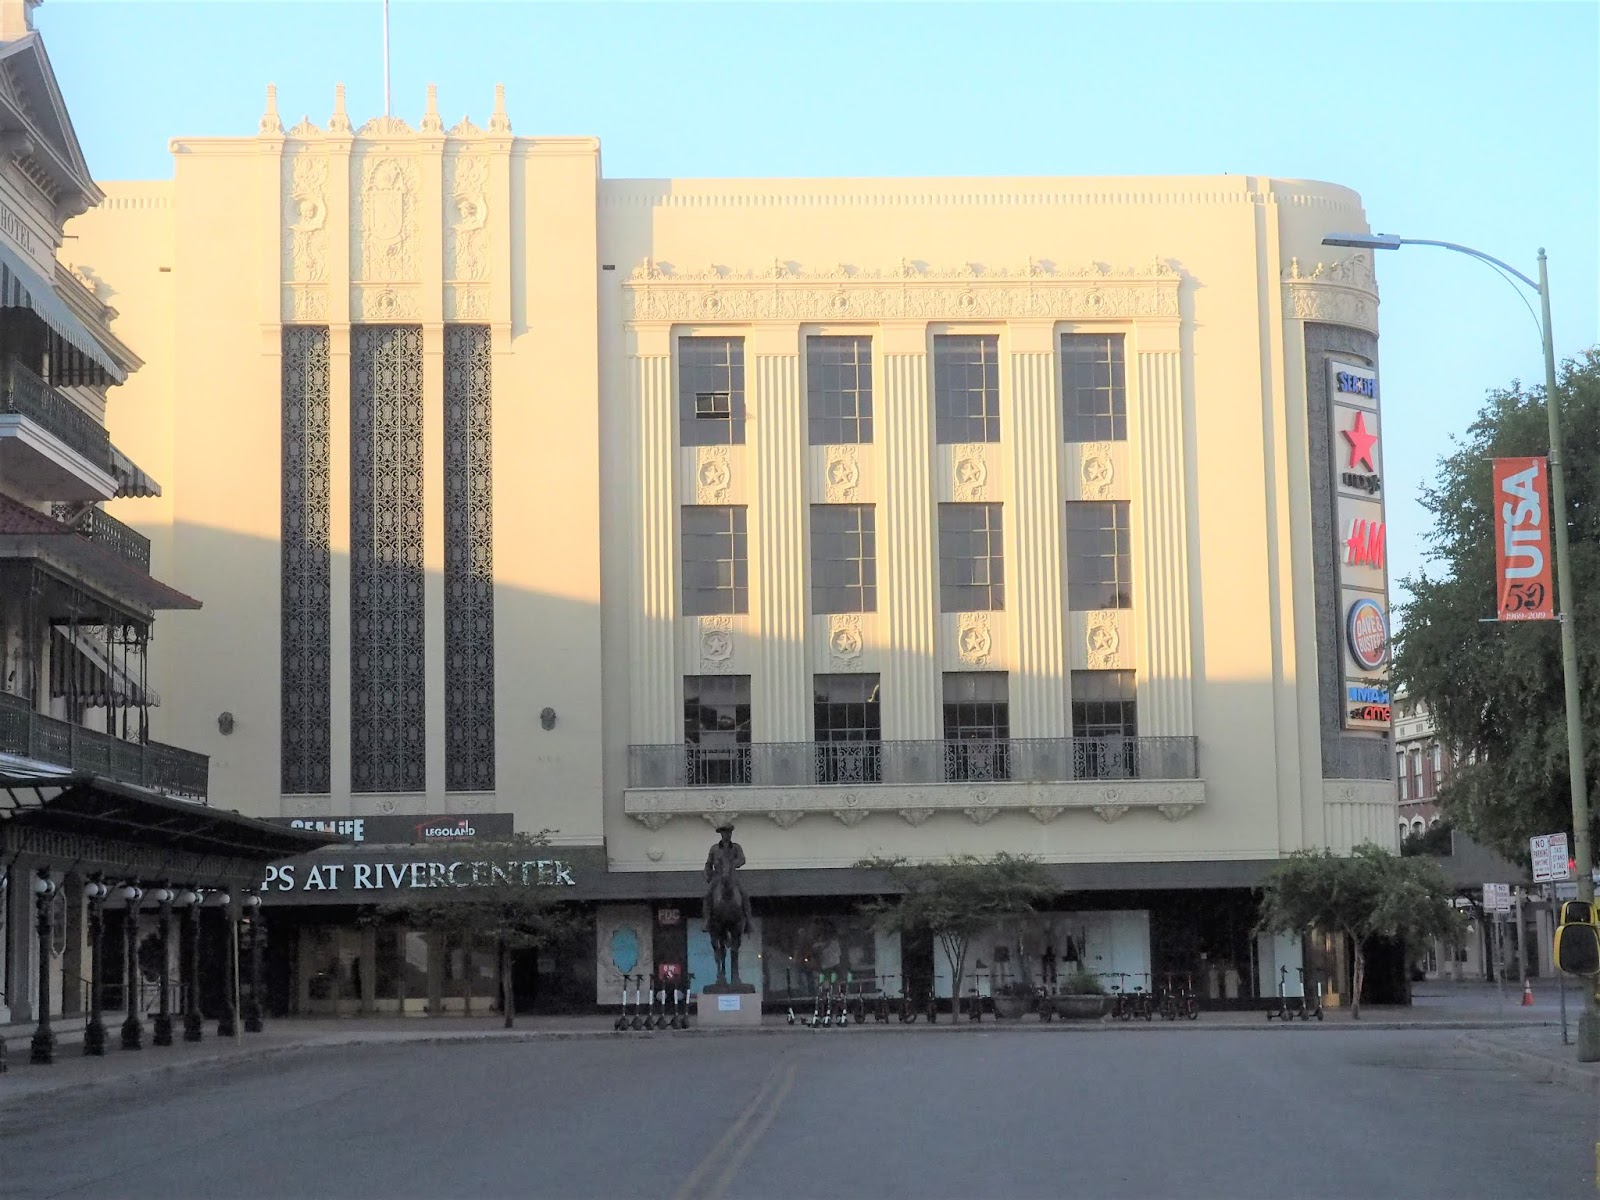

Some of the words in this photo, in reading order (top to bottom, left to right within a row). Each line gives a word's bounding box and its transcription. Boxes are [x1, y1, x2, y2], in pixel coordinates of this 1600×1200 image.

[1502, 465, 1543, 578] UTSA
[426, 820, 475, 836] LEGOLAND
[1535, 839, 1545, 849] NO
[303, 865, 344, 890] AT
